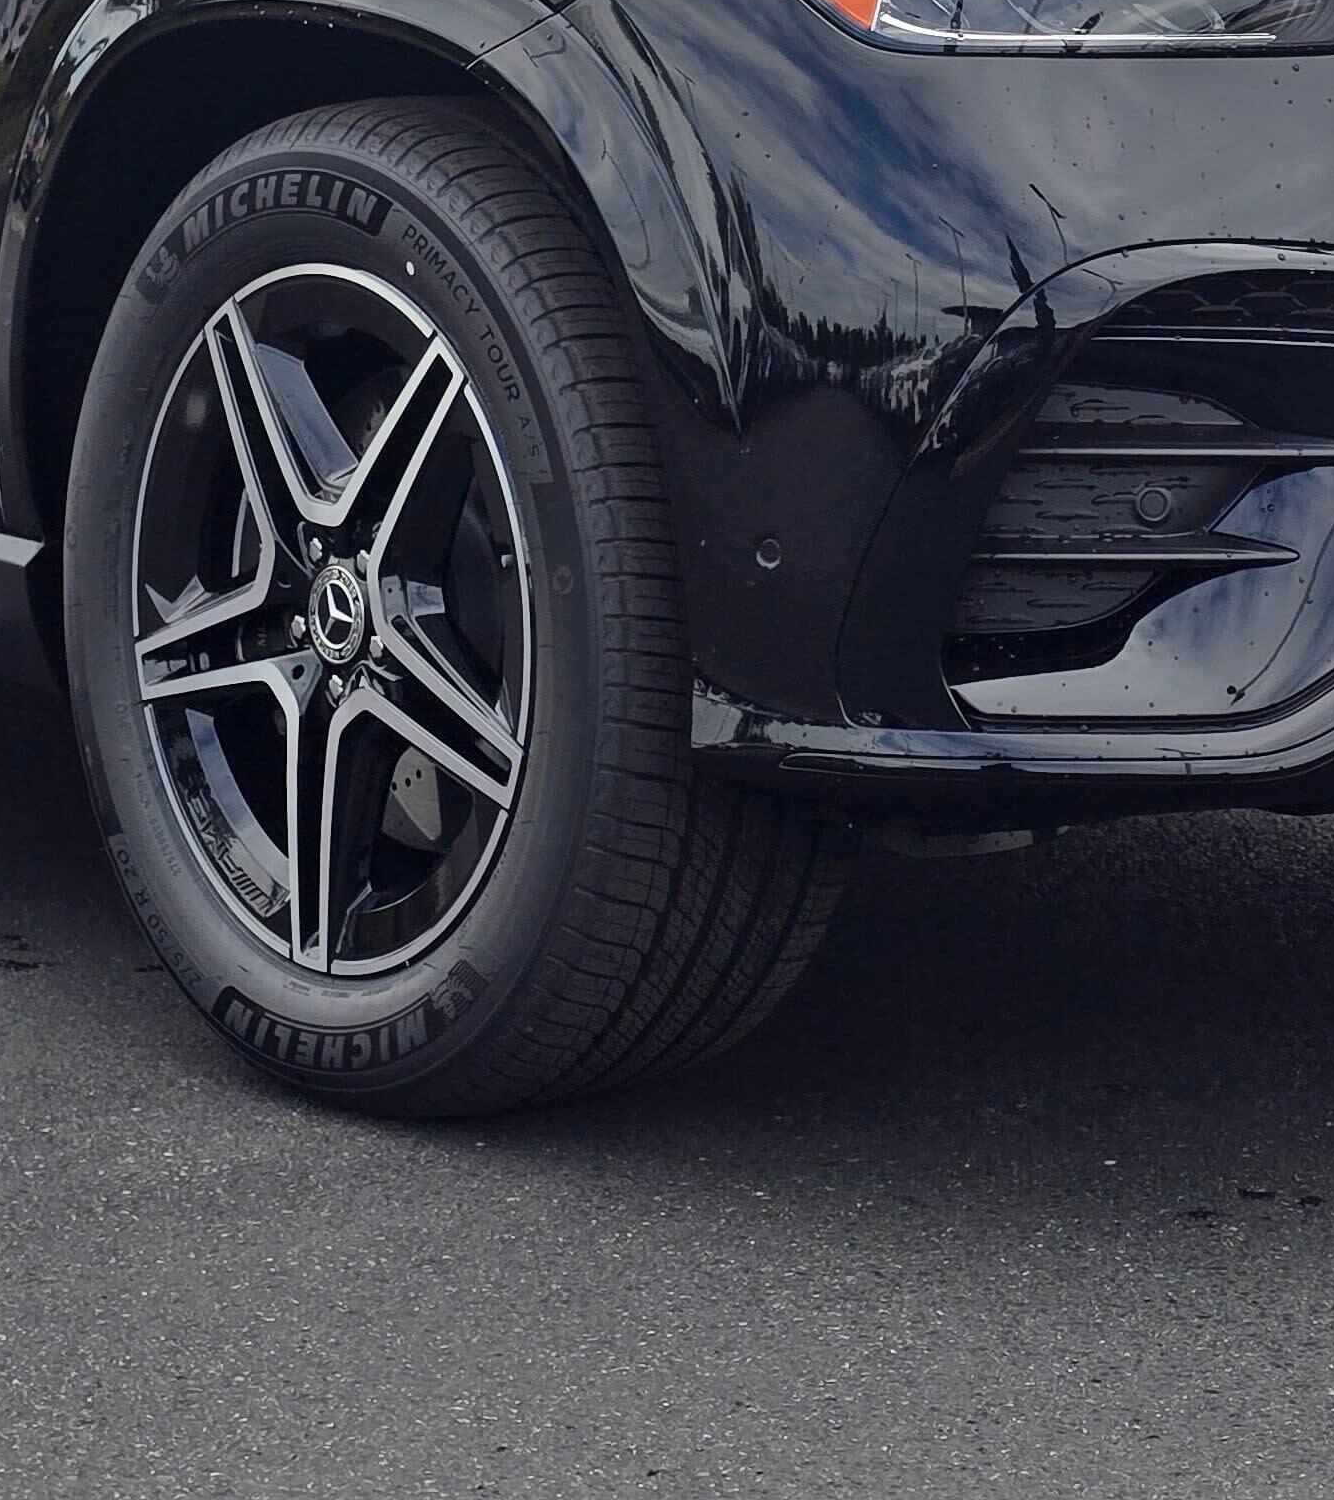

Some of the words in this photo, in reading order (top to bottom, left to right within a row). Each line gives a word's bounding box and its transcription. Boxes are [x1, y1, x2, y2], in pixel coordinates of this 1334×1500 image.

[183, 173, 377, 251] MICHELIN
[402, 224, 481, 316] PRIMACY
[479, 324, 521, 401] TOUR
[518, 415, 540, 458] A/S
[223, 999, 427, 1069] MICHELIN
